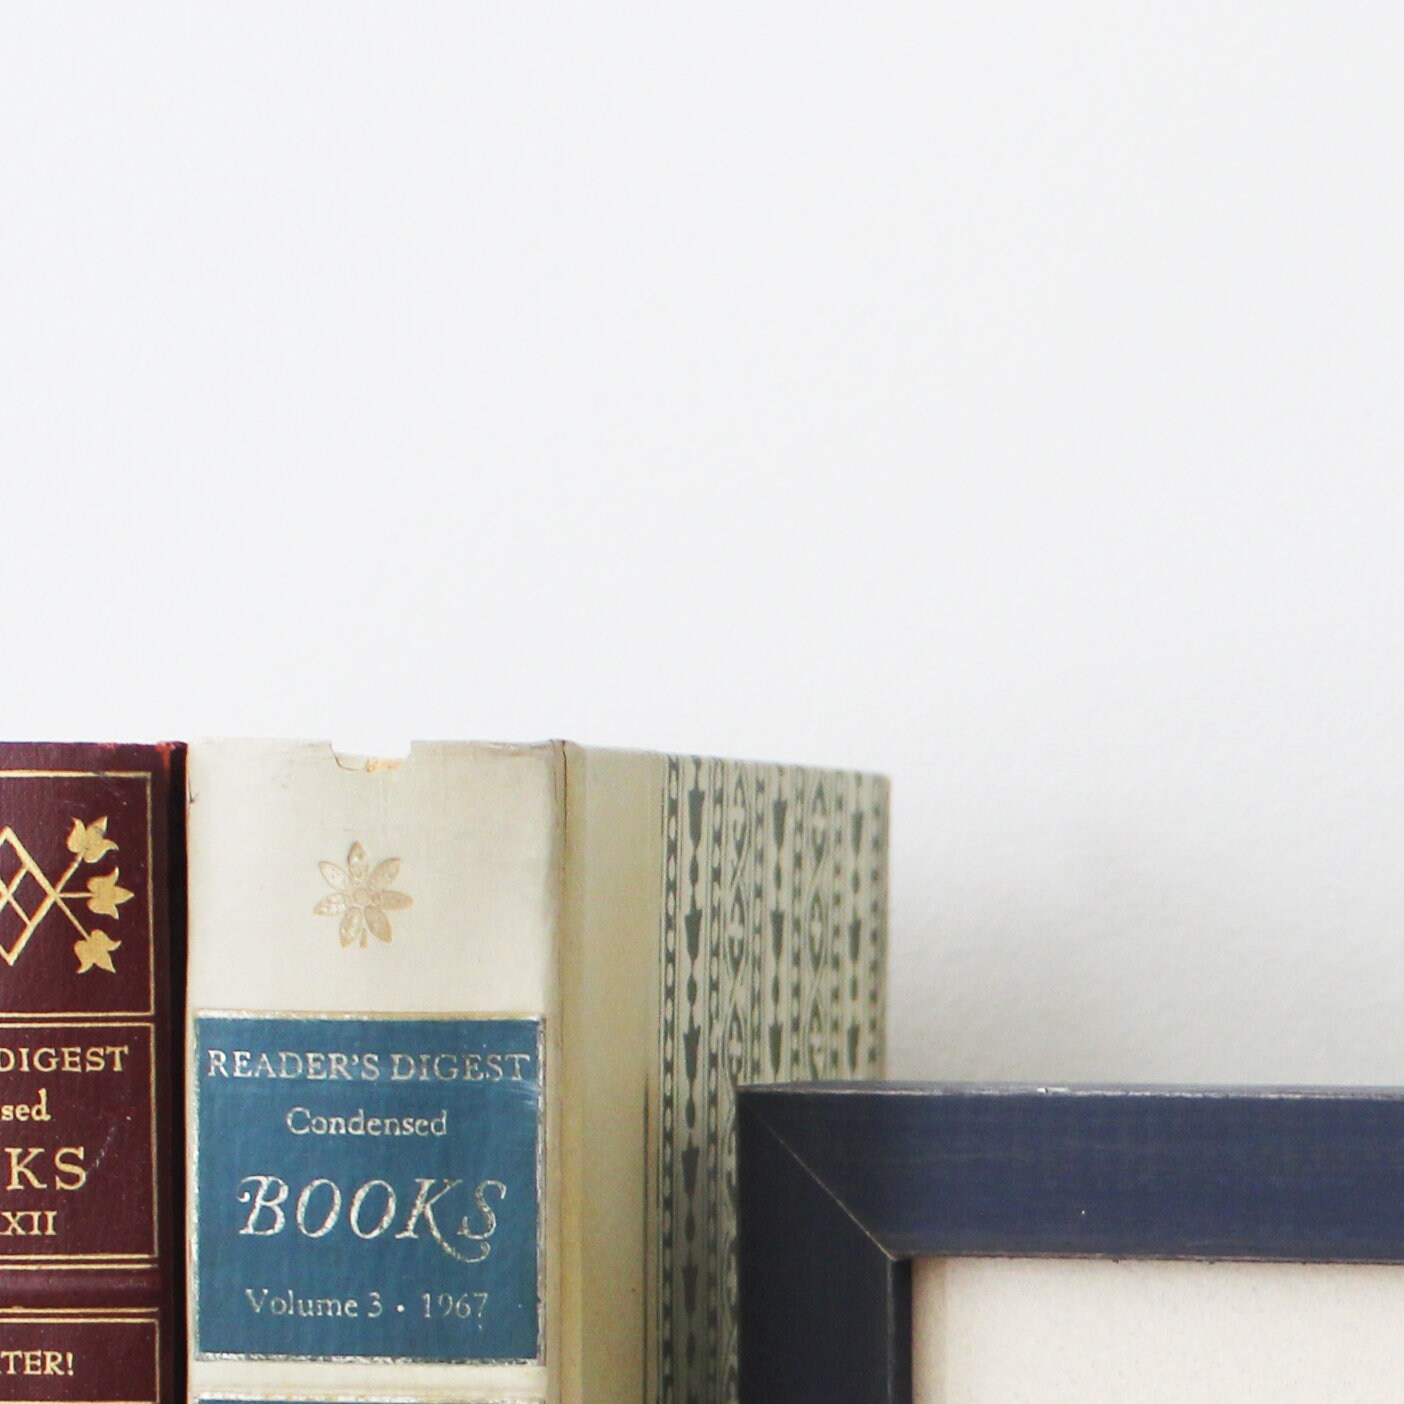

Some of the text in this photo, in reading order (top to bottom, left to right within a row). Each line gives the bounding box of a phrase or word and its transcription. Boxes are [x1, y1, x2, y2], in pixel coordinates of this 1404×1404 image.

[207, 1049, 531, 1082] READER'S DIGEST
[286, 1107, 448, 1136] Condensed
[5, 1146, 87, 1190] KS
[236, 1175, 507, 1263] BOOKS
[245, 1288, 489, 1318] Volume 3 1967
